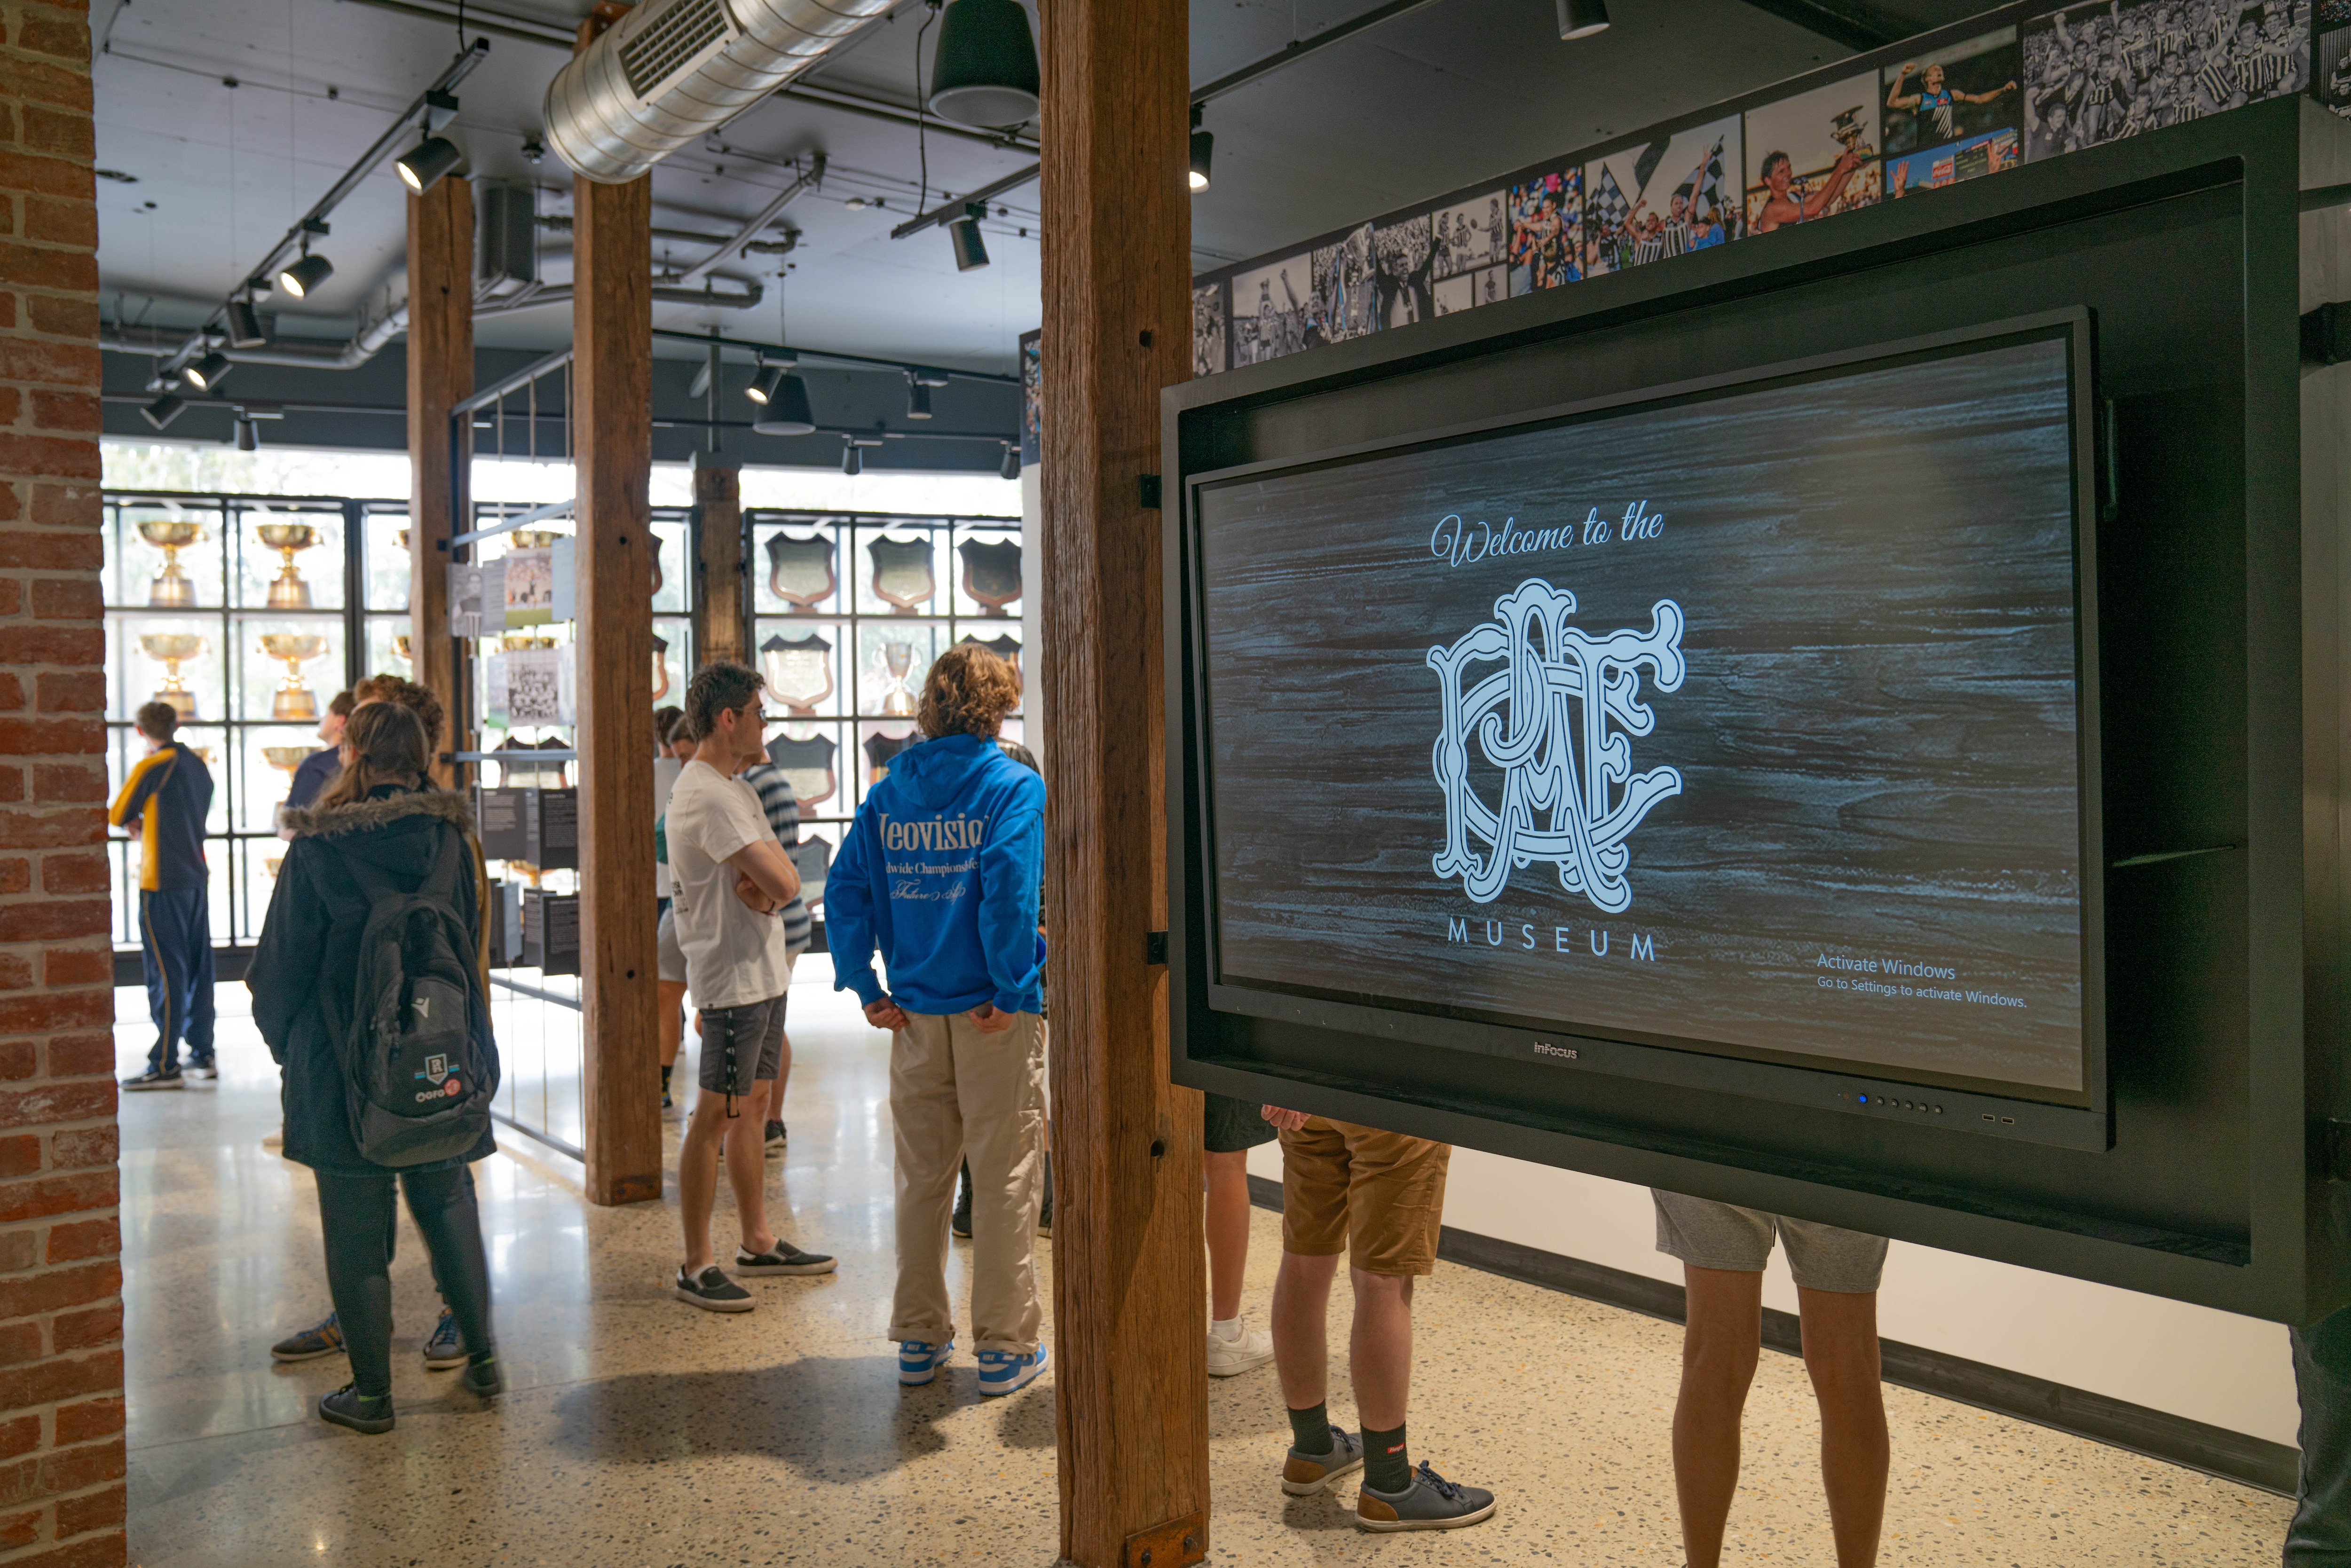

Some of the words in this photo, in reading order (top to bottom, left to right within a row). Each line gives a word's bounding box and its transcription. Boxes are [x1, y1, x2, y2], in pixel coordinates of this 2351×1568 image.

[1430, 513, 1574, 567] Welcome
[1583, 506, 1612, 545] to
[1621, 499, 1664, 542] the
[886, 861, 914, 874] dwide
[1448, 917, 1655, 961] MUSEUM
[1817, 953, 1878, 973] Activate
[1881, 958, 1956, 980] Windows
[1817, 976, 1833, 988] Go
[1836, 978, 1848, 989] to
[1851, 979, 1897, 997] Settings
[1900, 985, 1913, 996] to
[1916, 986, 1962, 1001] activate
[1965, 990, 2028, 1008] Windows.
[1534, 1041, 1578, 1059] InFocus
